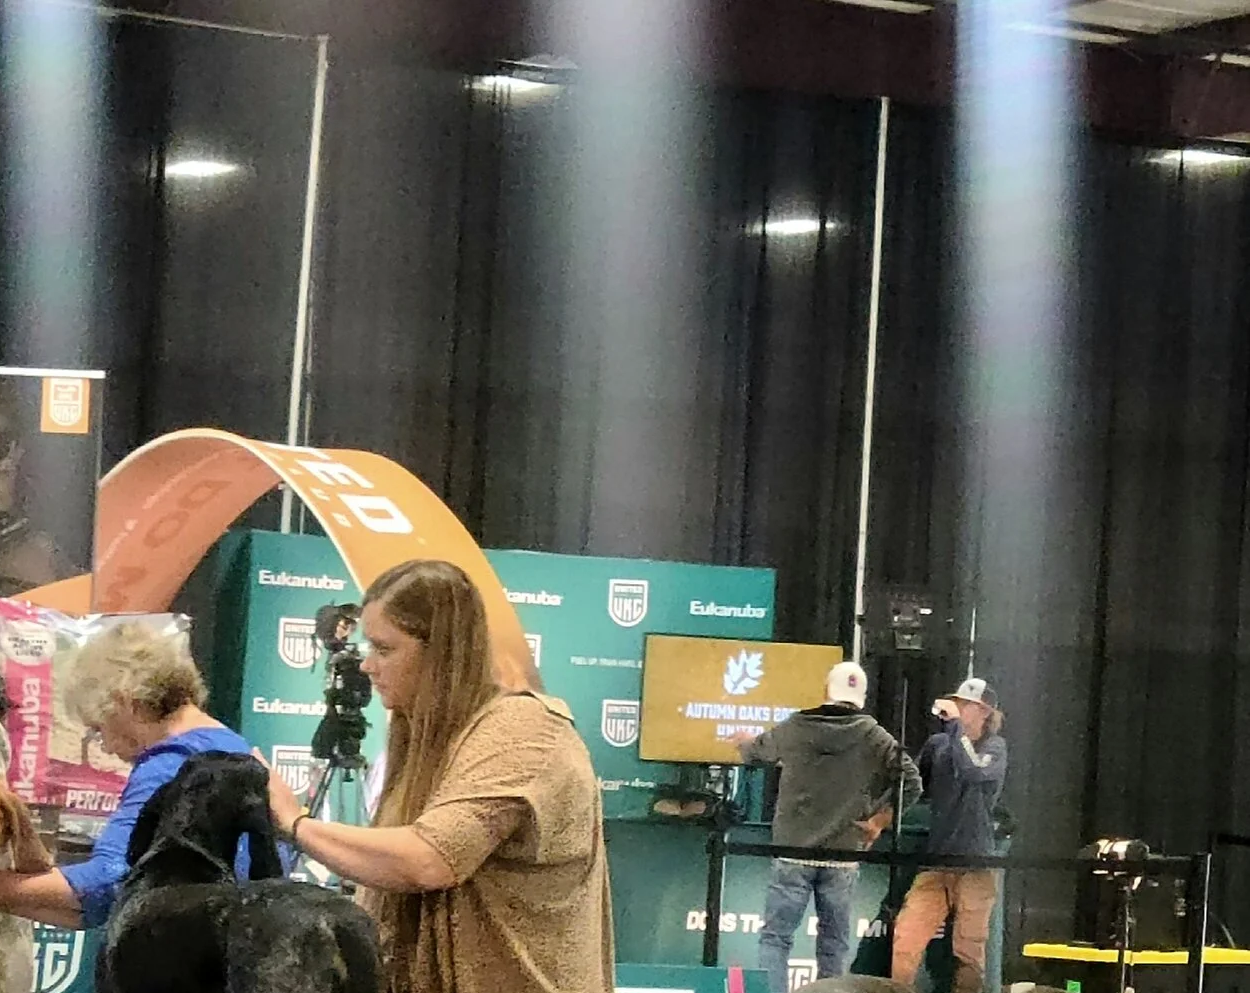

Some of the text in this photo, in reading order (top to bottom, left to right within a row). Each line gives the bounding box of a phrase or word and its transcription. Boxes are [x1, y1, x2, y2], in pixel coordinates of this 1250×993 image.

[258, 570, 345, 590] Eukanuba
[502, 588, 562, 606] kanuba
[614, 598, 643, 621] UKC
[690, 600, 766, 618] Eukanuba
[252, 697, 327, 716] Eukanub
[686, 702, 735, 719] AUTUMN
[738, 705, 770, 721] OAKS
[606, 718, 636, 742] UKC
